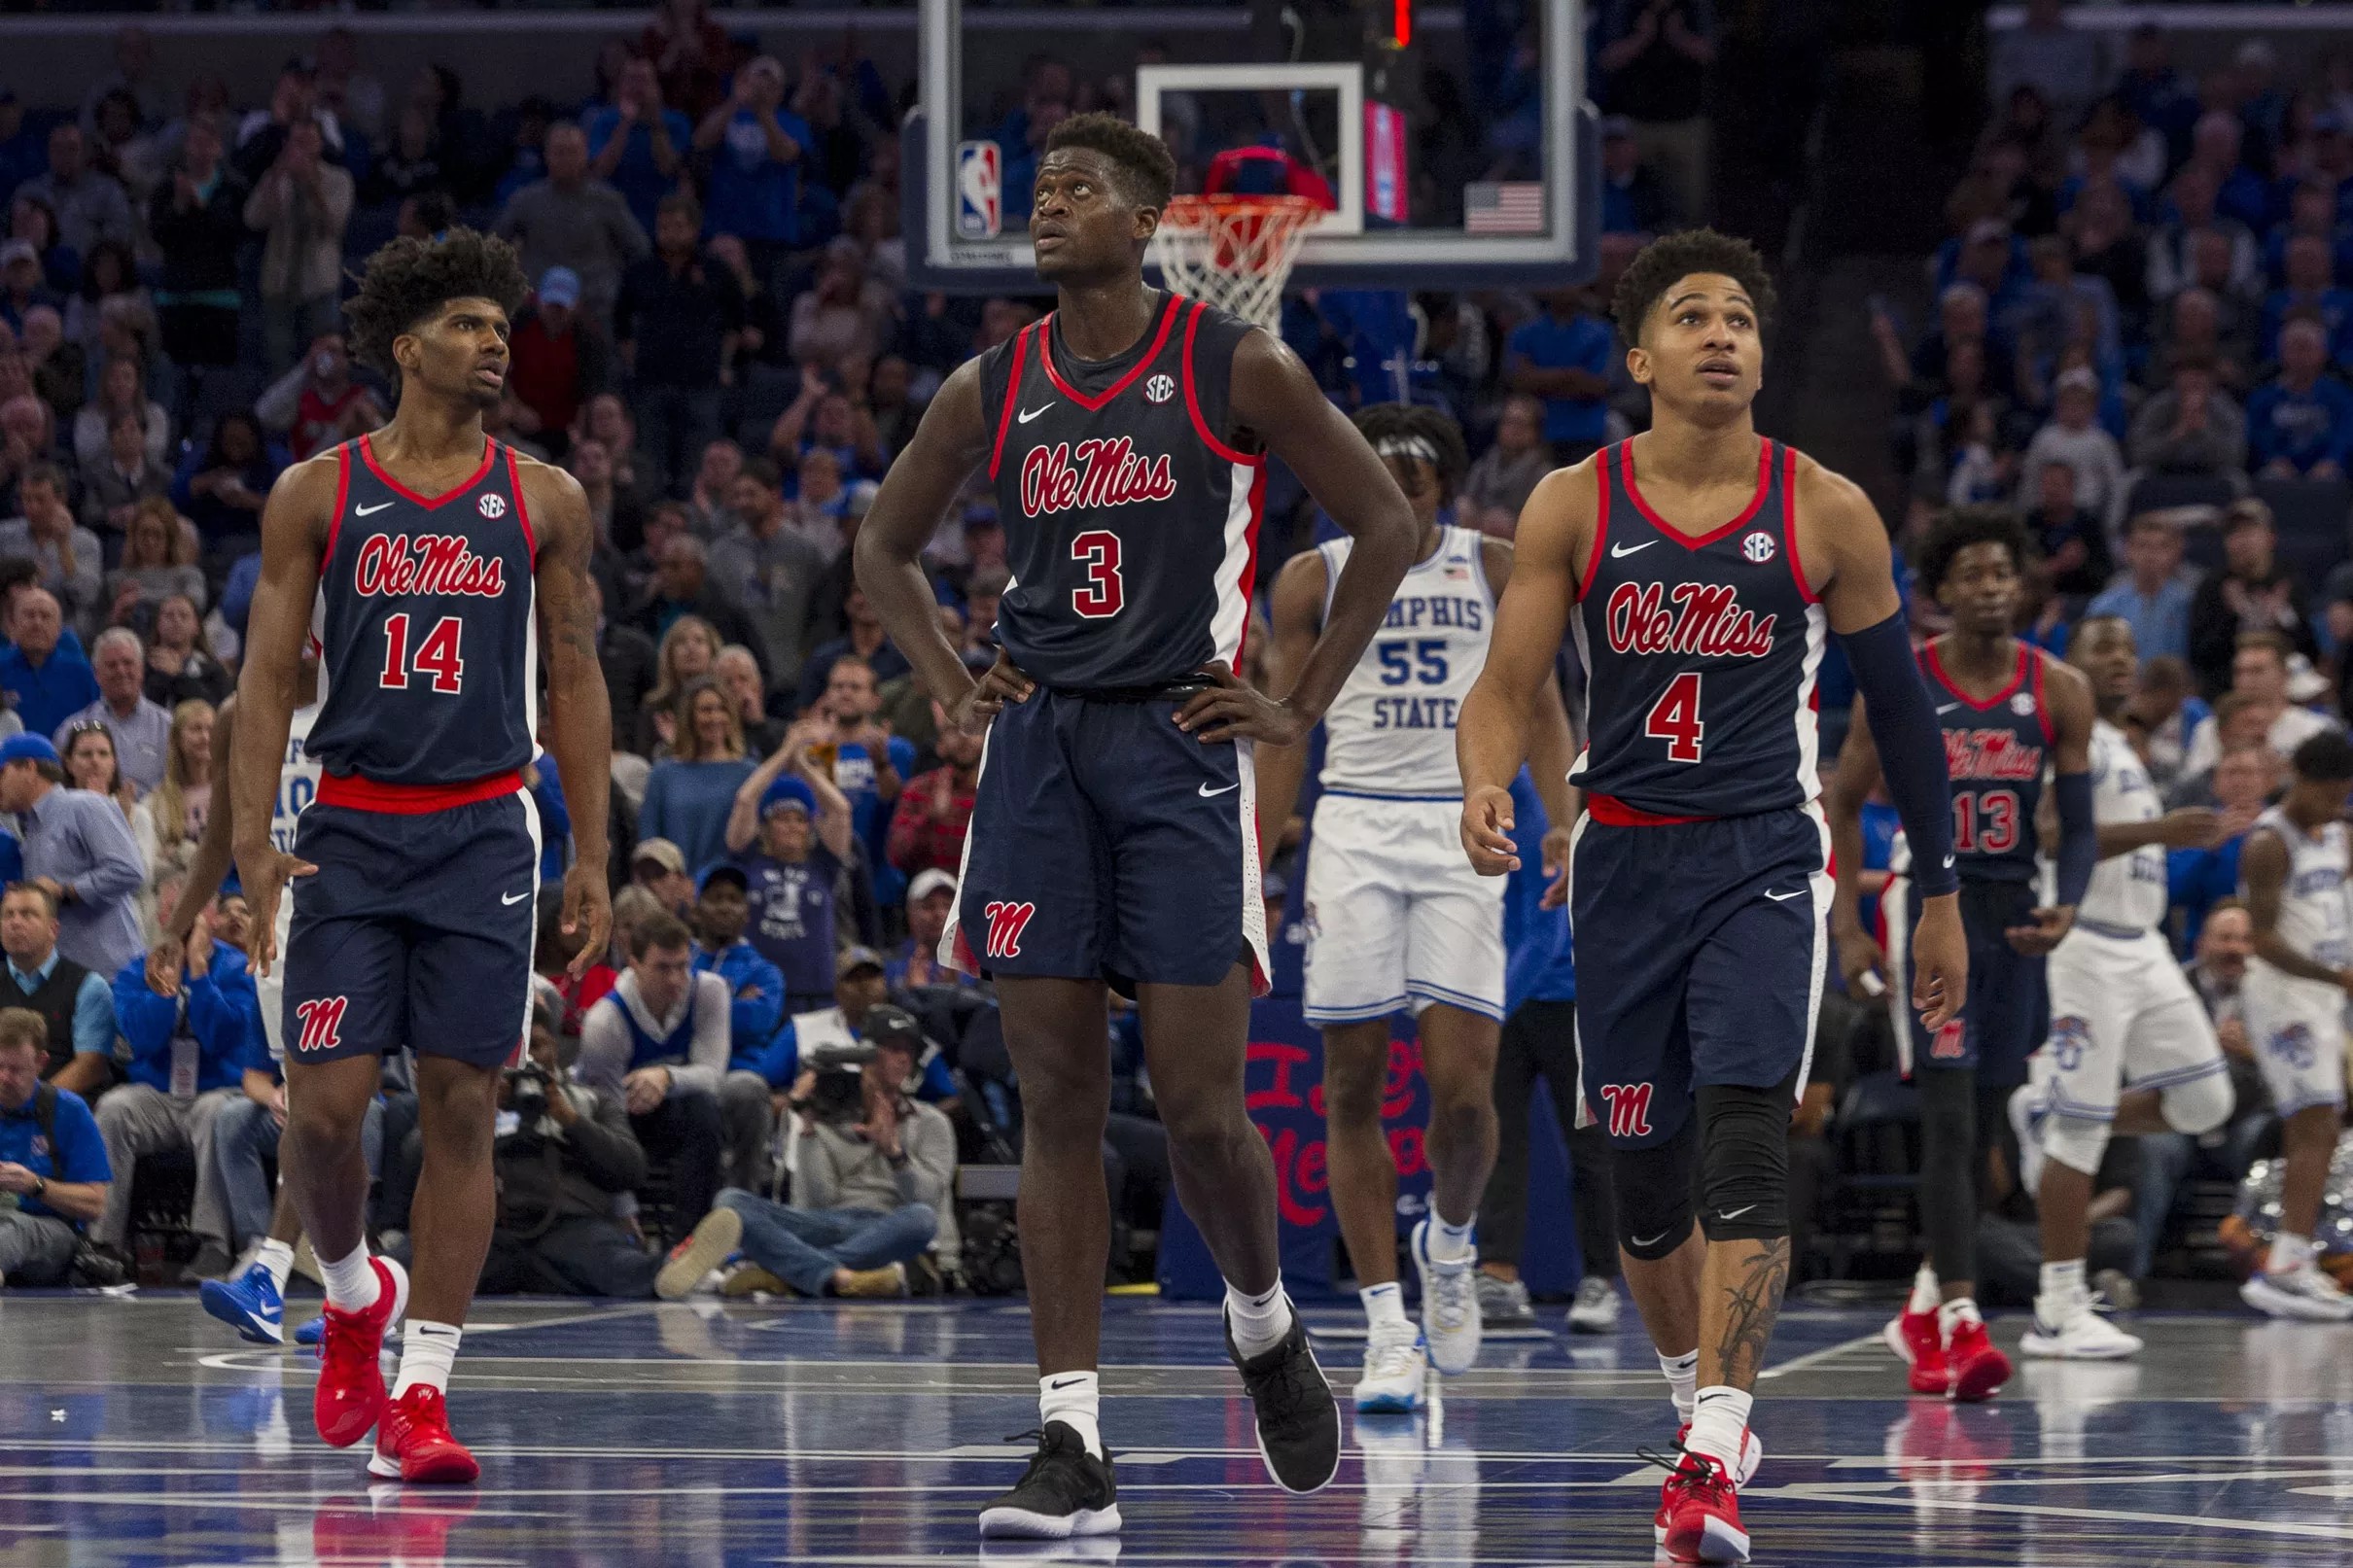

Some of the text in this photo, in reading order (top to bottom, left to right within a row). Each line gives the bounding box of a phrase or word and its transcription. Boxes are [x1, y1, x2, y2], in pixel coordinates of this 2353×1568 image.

[1145, 374, 1175, 402] SEC
[478, 493, 507, 518] SEC
[1022, 436, 1177, 517] Ole Miss
[355, 533, 506, 597] Ole Miss
[1071, 530, 1124, 618] 3
[1743, 532, 1775, 562] SEC
[1606, 581, 1778, 657] Ole Miss
[379, 612, 464, 694] 14
[1377, 640, 1449, 686] 55
[1373, 696, 1457, 729] STATE
[1645, 673, 1703, 763] 4
[1951, 789, 2020, 854] 13
